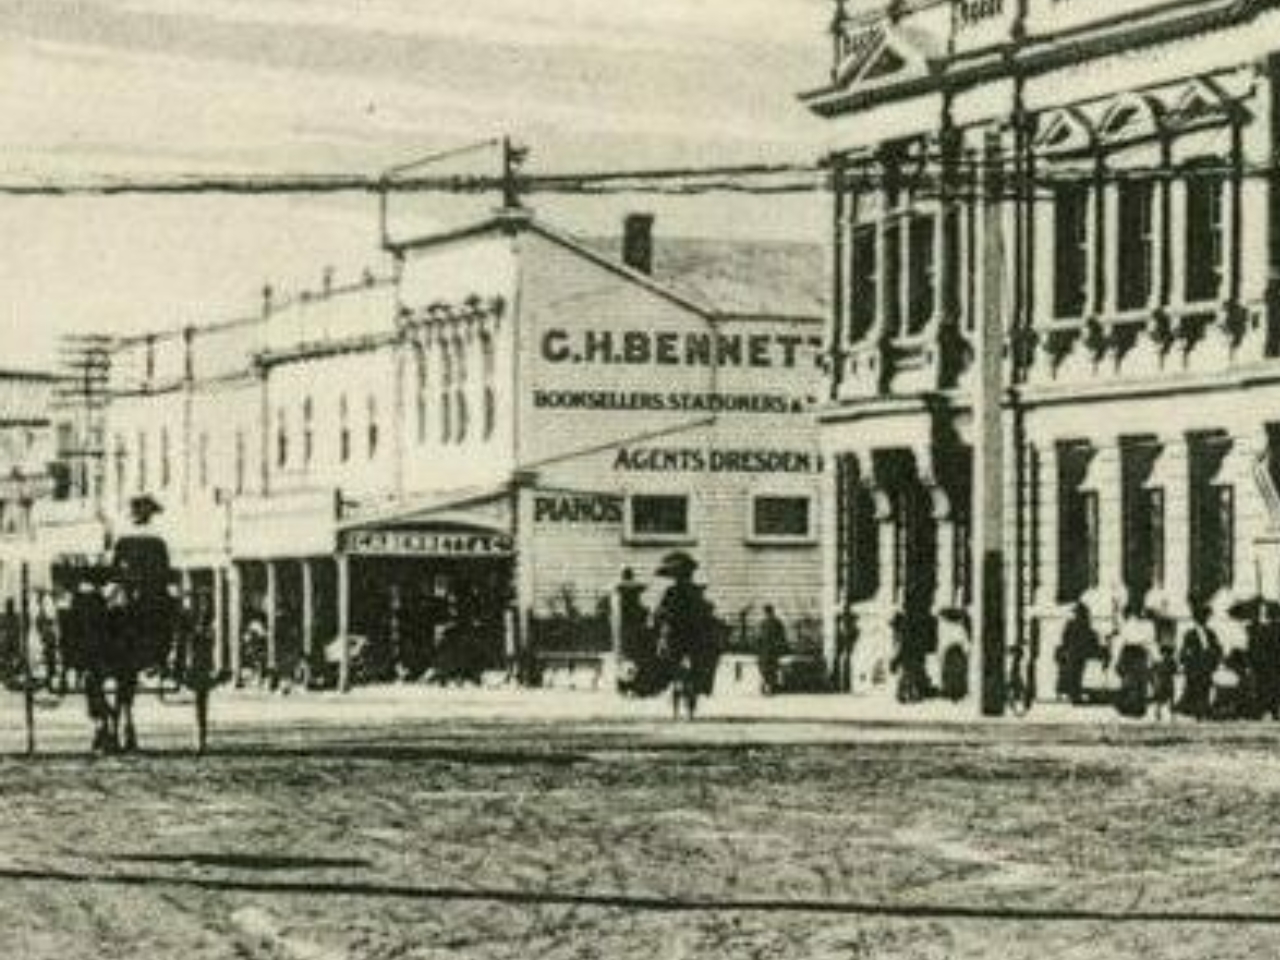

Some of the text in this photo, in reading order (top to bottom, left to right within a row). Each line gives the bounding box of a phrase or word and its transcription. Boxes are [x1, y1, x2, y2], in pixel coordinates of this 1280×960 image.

[613, 448, 705, 472] AGENTS
[709, 451, 810, 472] DRESDEN
[534, 496, 624, 522] PIANOS
